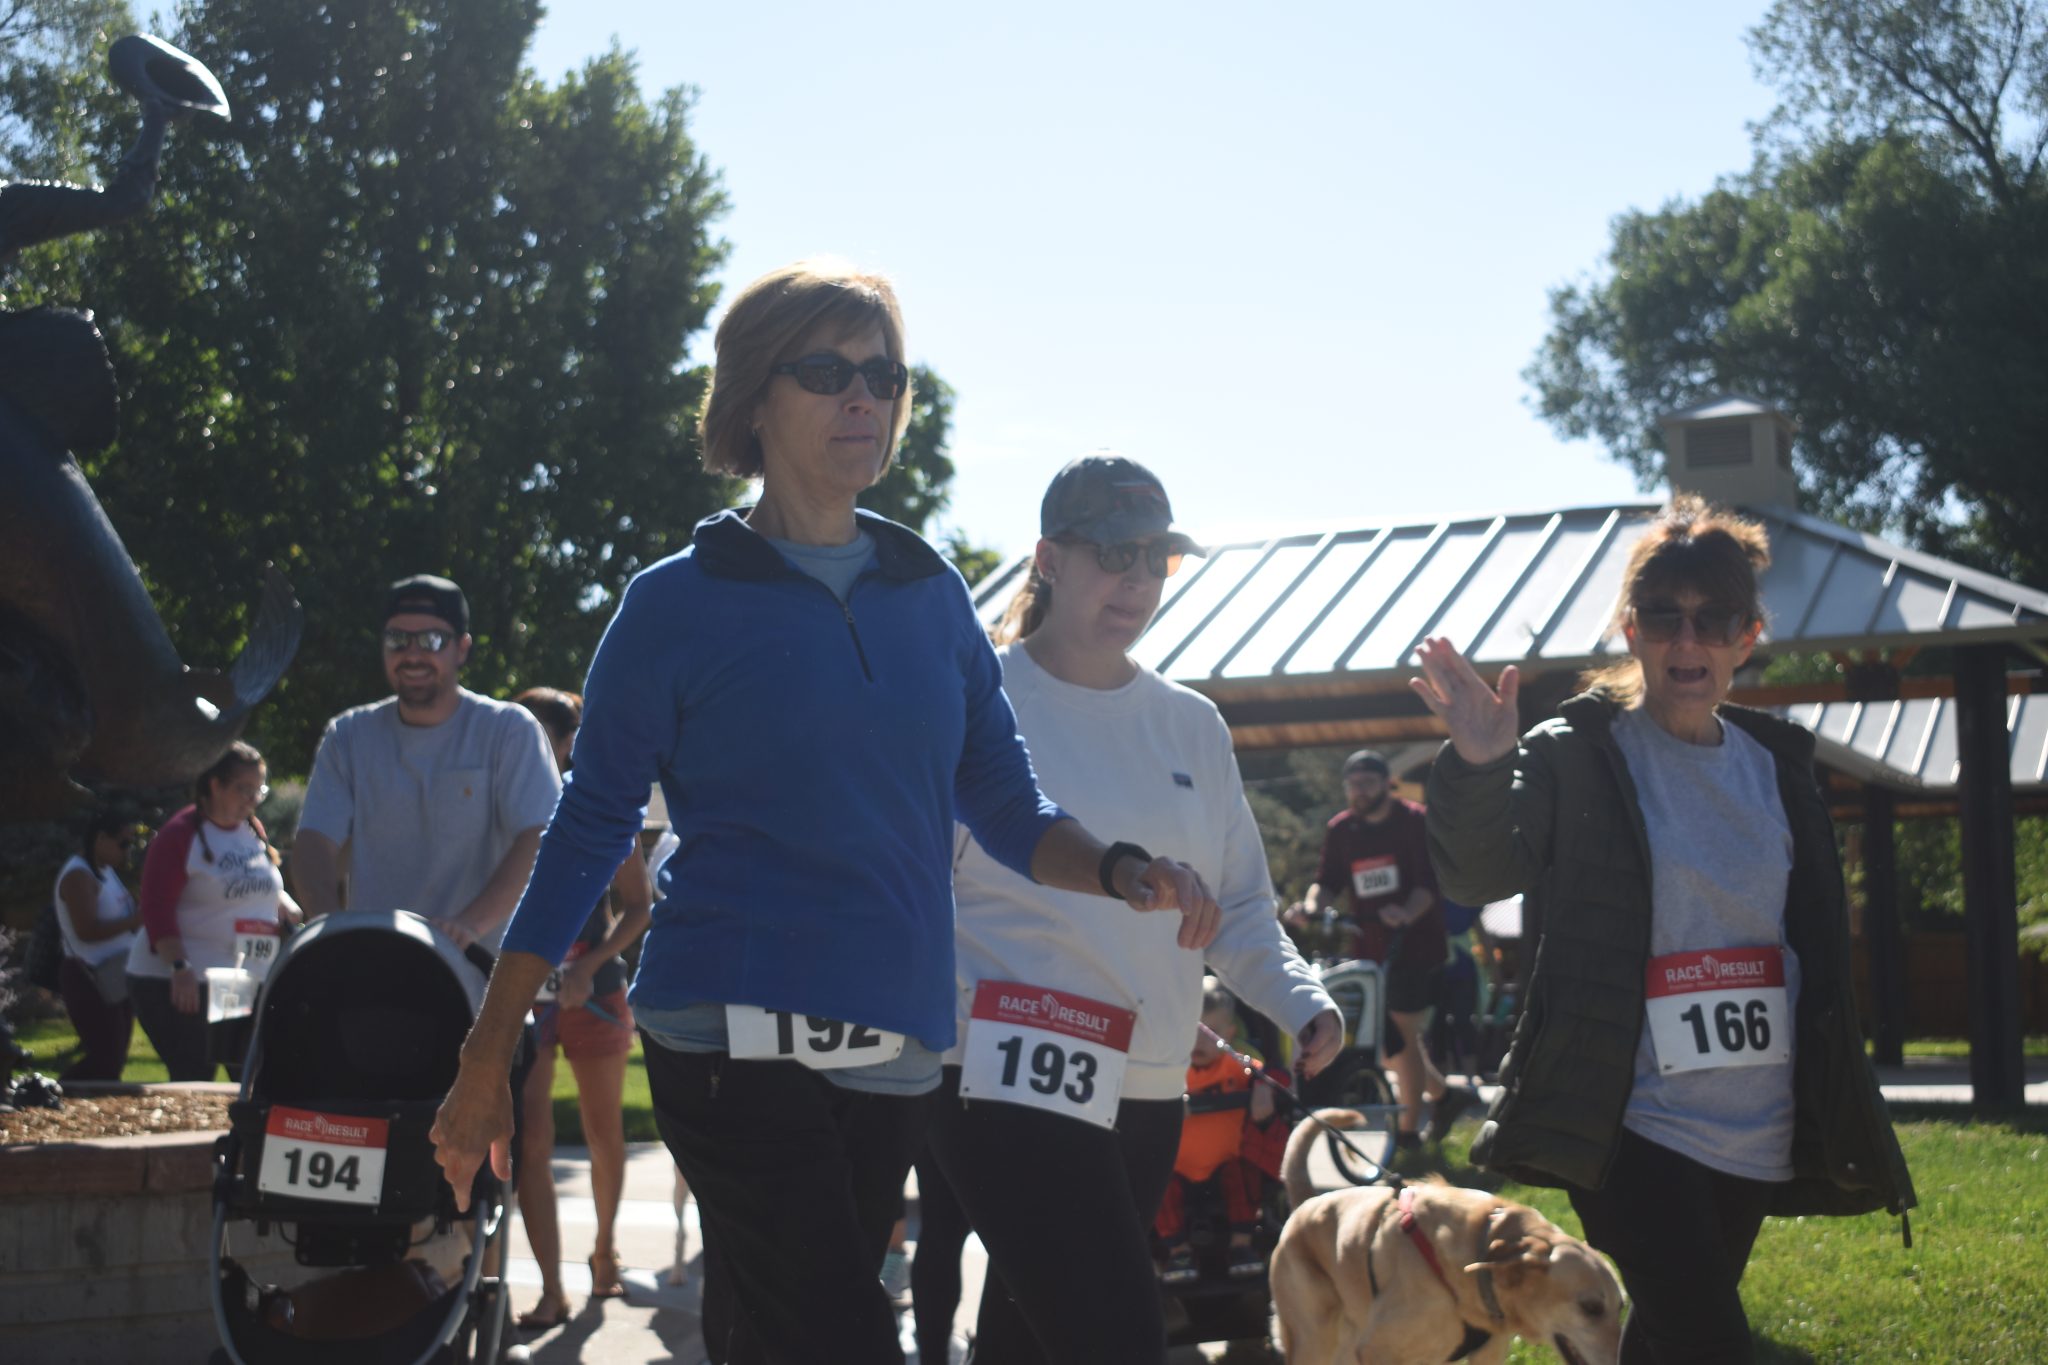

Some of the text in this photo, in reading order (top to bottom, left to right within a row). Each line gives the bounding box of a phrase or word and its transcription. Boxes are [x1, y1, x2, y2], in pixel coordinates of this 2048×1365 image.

[1665, 960, 1765, 983] RACE RESULT
[999, 995, 1041, 1014] RACE
[1058, 1006, 1111, 1032] RESULT
[1680, 999, 1771, 1054] 166
[997, 1035, 1098, 1104] 193
[284, 1116, 315, 1132] RACE
[327, 1123, 369, 1139] RESULT
[284, 1147, 361, 1191] 194
